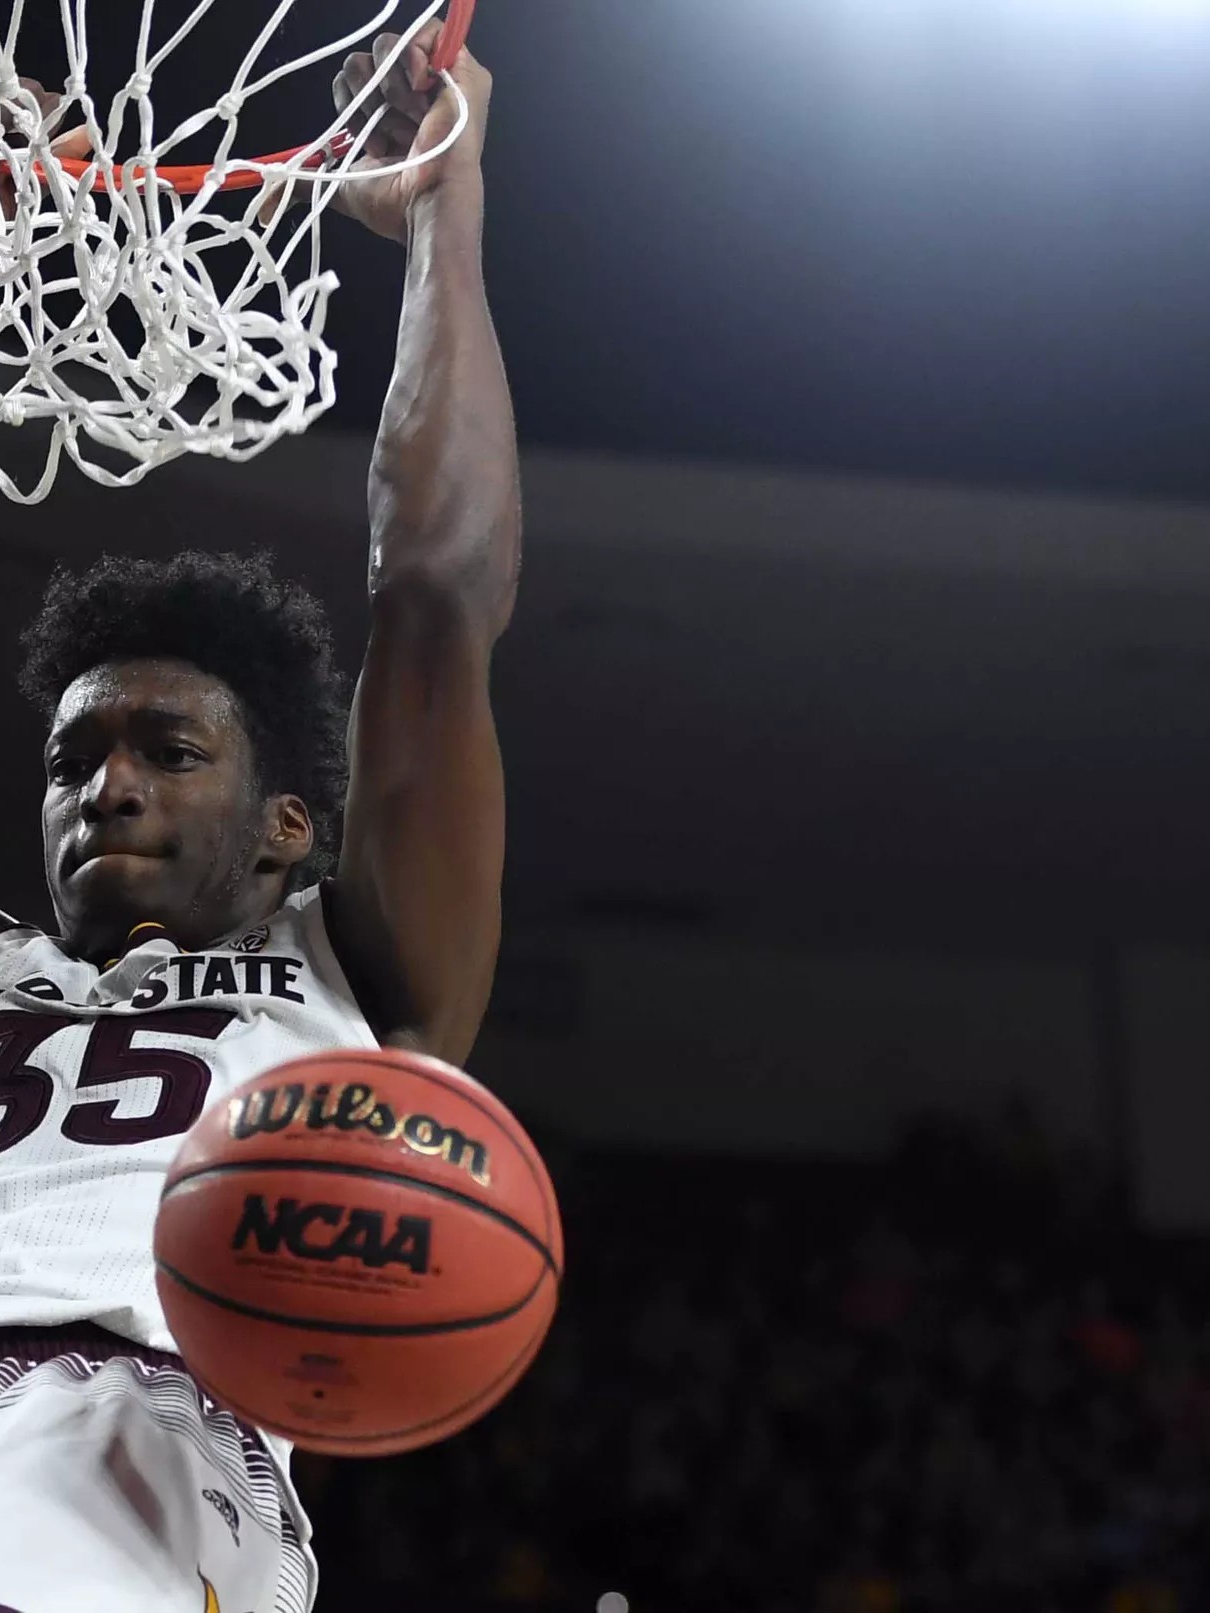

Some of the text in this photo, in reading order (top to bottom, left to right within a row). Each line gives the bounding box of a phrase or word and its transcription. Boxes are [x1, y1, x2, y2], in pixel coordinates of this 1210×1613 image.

[131, 956, 305, 1009] STATE
[228, 1082, 491, 1187] Wilson
[232, 1194, 432, 1274] NCAA
